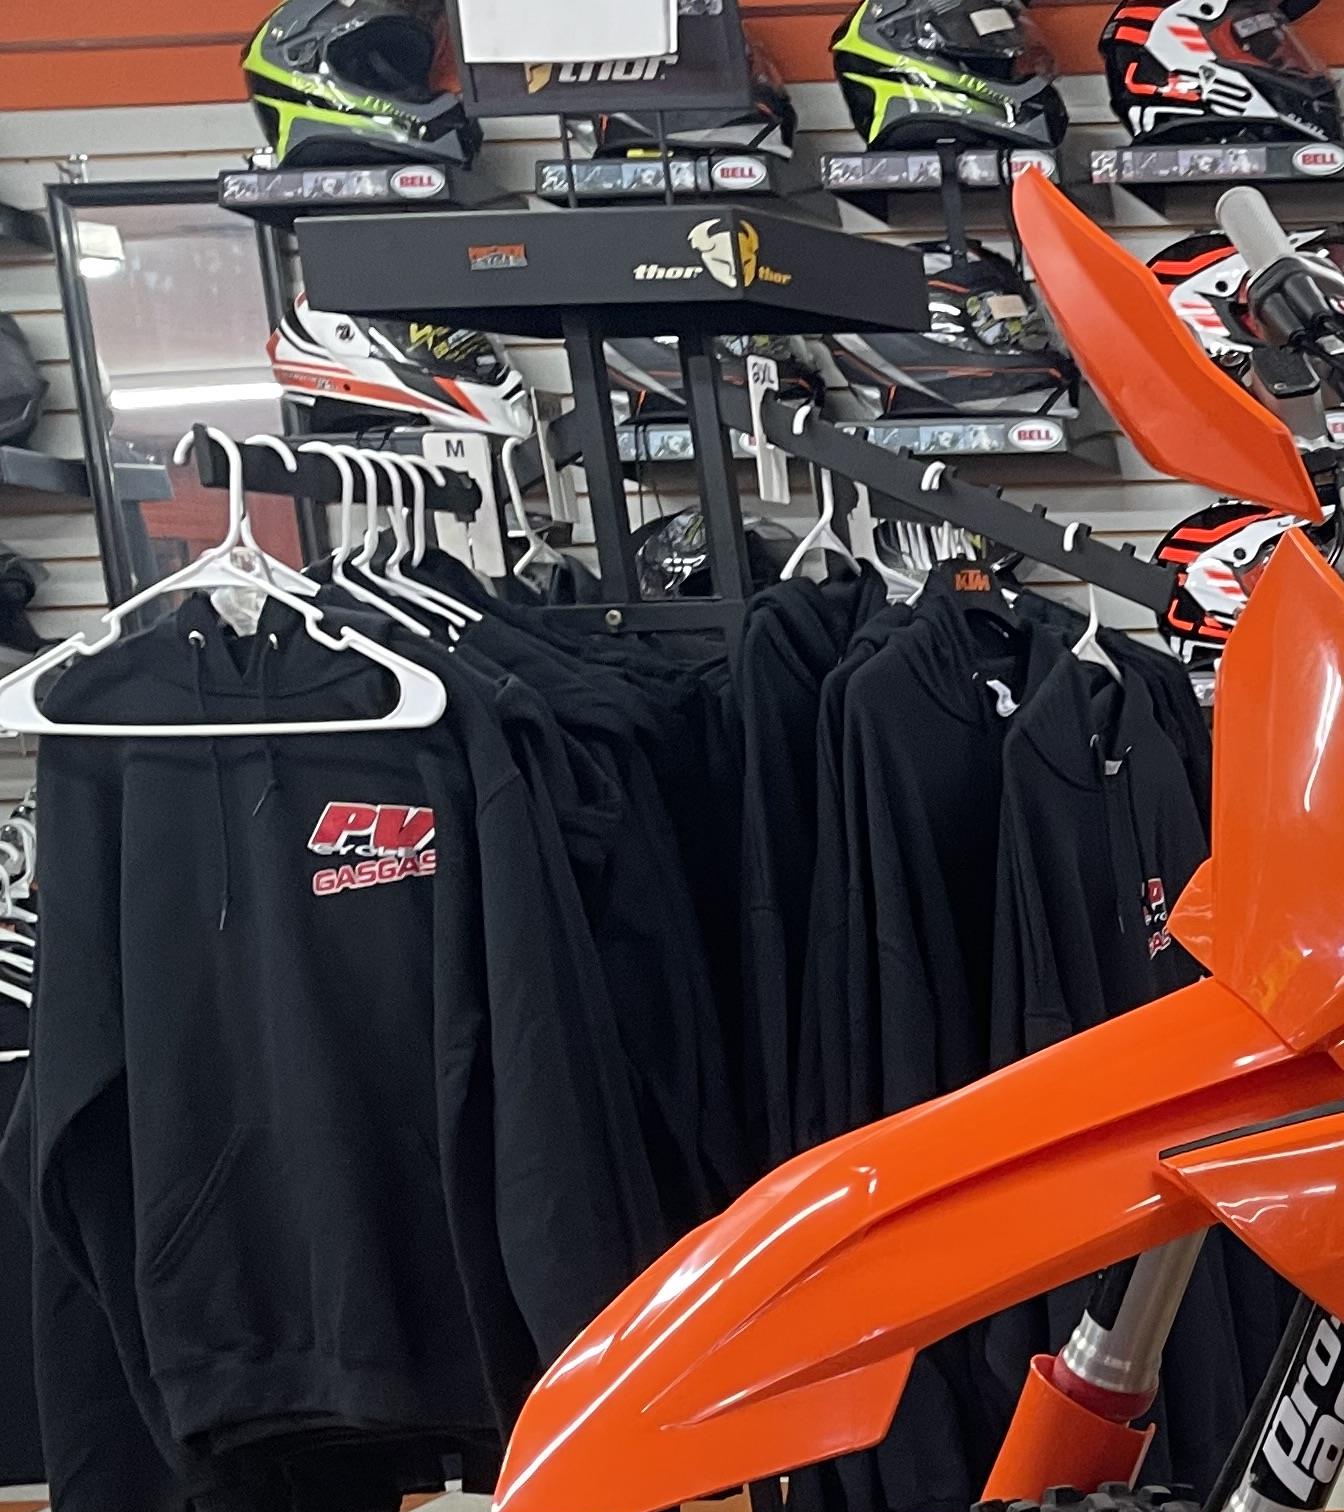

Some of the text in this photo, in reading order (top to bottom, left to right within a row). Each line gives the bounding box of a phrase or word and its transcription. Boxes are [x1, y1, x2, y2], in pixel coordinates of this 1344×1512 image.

[1301, 153, 1338, 166] BELL
[398, 175, 435, 188] BELL
[719, 166, 757, 180] BELL
[632, 263, 704, 281] thor
[757, 265, 792, 285] thor
[1017, 429, 1054, 442] BELL
[445, 439, 465, 457] M
[954, 569, 992, 592] KTM
[307, 801, 436, 851] PV
[313, 849, 437, 896] GASGAS
